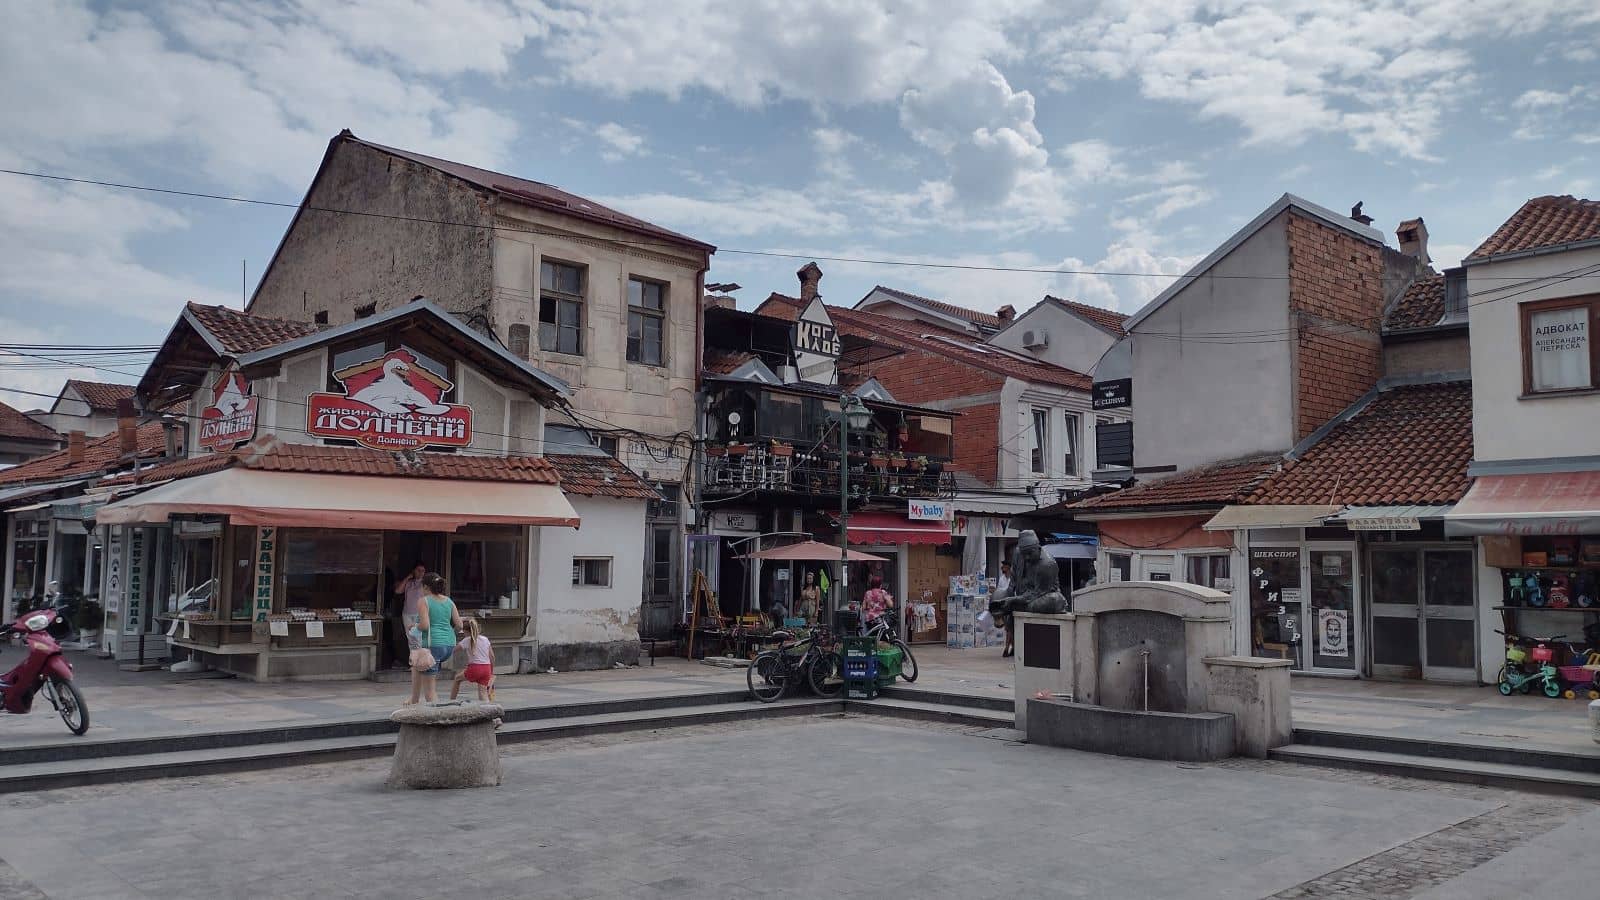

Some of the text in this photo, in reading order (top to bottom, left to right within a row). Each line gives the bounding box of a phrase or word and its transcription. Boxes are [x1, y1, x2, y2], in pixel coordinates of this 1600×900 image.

[1535, 322, 1585, 336] АДВОКАТ
[1535, 336, 1586, 346] АЛЕКСАНДРА
[318, 407, 466, 425] ЖИВИНАРСКА ФАРМА
[314, 414, 465, 439] ДОЛНЕНИ
[376, 435, 418, 446] Долнени
[1253, 551, 1298, 559] ШЕКСПИР
[256, 525, 274, 623] УВАЧНИЦА
